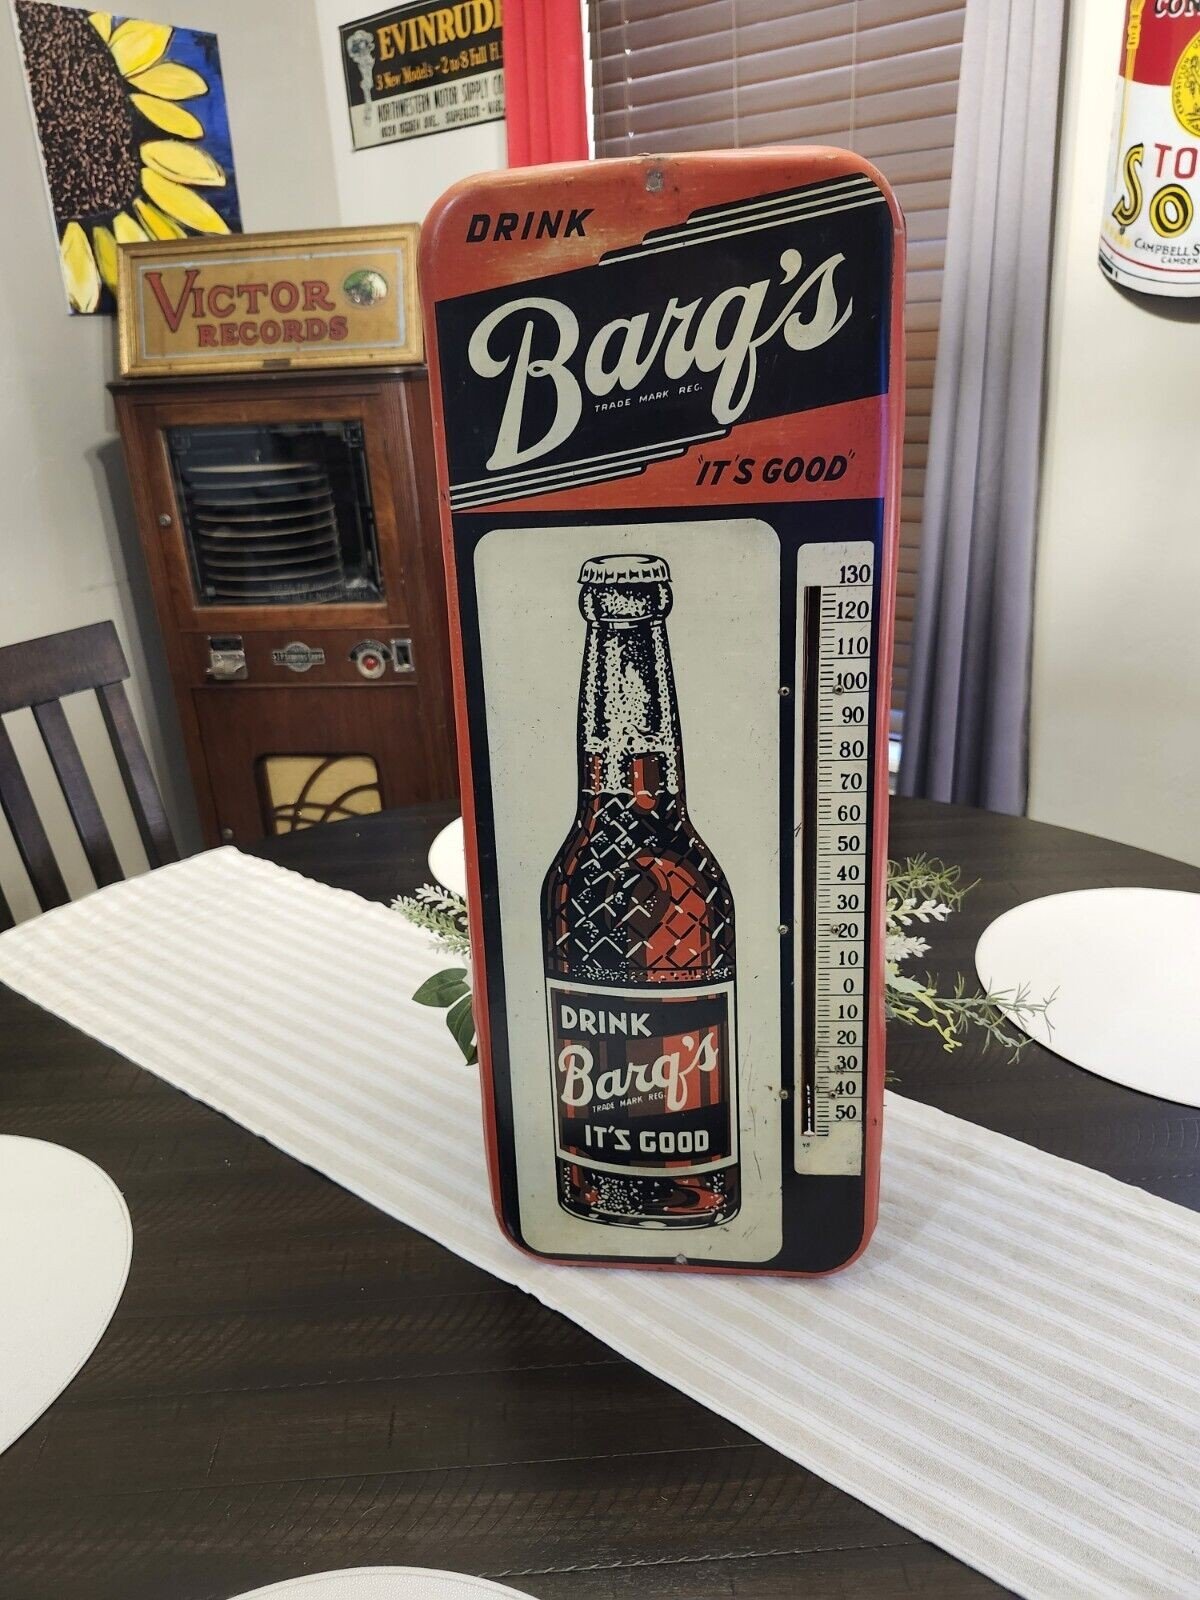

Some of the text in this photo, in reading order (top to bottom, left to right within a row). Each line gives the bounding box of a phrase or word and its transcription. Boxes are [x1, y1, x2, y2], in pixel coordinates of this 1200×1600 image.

[401, 62, 434, 84] Models
[459, 50, 469, 69] 8
[377, 90, 431, 122] NORTHWESTERN
[434, 85, 458, 109] MOTOR
[462, 77, 489, 102] SUPPLY
[466, 209, 594, 243] DRINK
[1134, 238, 1190, 256] CAMPBELL
[145, 270, 336, 333] VICTOR
[197, 316, 348, 347] RECORDS
[468, 249, 853, 471] Barq's
[594, 383, 703, 413] TRADE MARK REG.
[839, 564, 870, 583] 130
[836, 602, 869, 619] 120
[838, 637, 868, 655] 110
[837, 672, 868, 690] 100
[842, 706, 864, 724] 90
[839, 740, 864, 758] 80
[840, 773, 862, 790] 70
[838, 804, 861, 821] 60
[838, 836, 860, 852] 50
[837, 865, 859, 880] 40
[837, 894, 859, 910] 30
[838, 922, 858, 938] 20
[839, 950, 858, 965] 10
[843, 978, 854, 993] 0
[561, 1004, 652, 1037] DRINK
[839, 1004, 858, 1019] 10
[837, 1031, 857, 1045] 20
[558, 1032, 719, 1111] Barq's
[837, 1055, 858, 1070] 30
[835, 1081, 857, 1095] 40
[592, 1091, 666, 1113] TRADE MARK REG.
[835, 1105, 857, 1119] 50
[584, 1124, 710, 1154] IT'S GOOD
